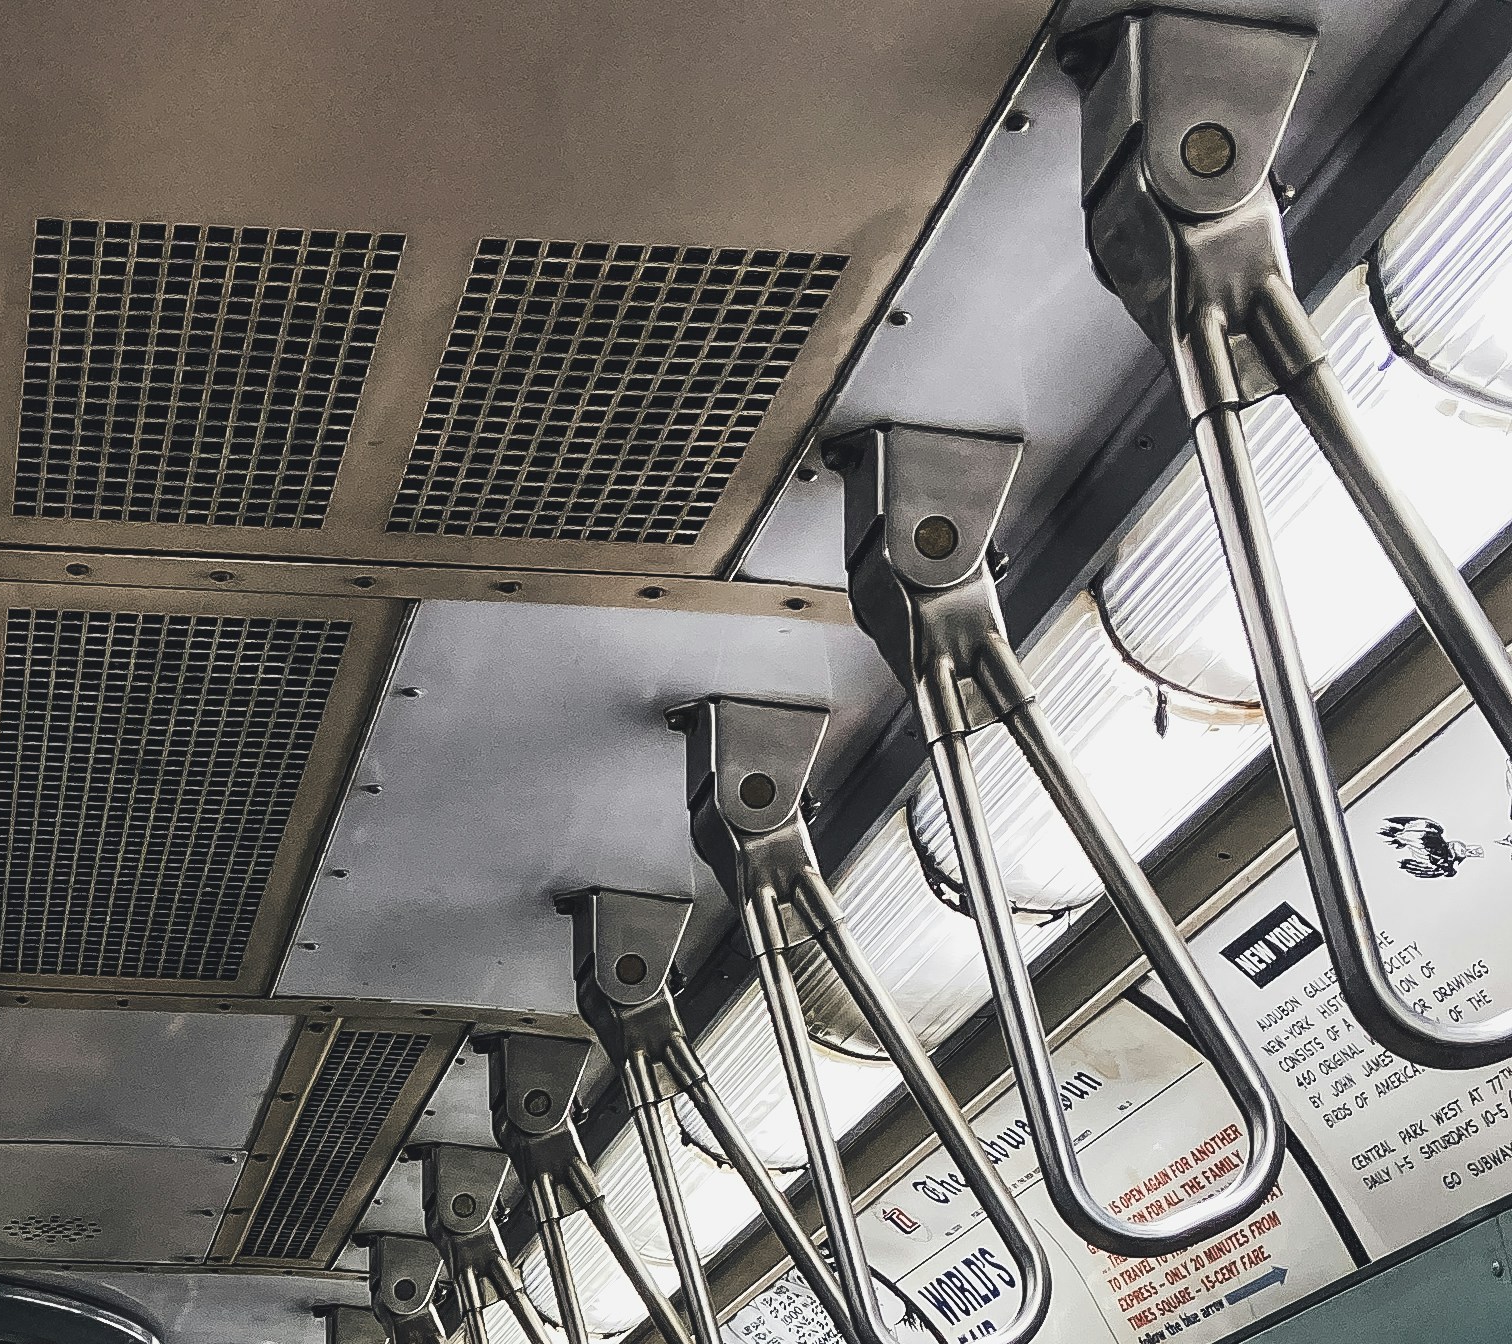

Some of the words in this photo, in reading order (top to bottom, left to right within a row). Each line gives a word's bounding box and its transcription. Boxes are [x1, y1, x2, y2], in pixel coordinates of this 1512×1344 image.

[1235, 941, 1269, 976] NEW
[1265, 914, 1313, 956] YORK
[1256, 996, 1302, 1032] AUDUBON
[1261, 1015, 1315, 1056] NEW-YORK
[1383, 941, 1422, 975] OCIETY
[1278, 1037, 1325, 1073] CONSISTS
[1326, 1025, 1340, 1042] OF
[1421, 960, 1436, 979] OF
[1295, 1069, 1317, 1090] 460
[1319, 1043, 1365, 1076] ORIGINAL
[1432, 959, 1490, 1003] DRAWINGS
[1309, 1094, 1324, 1109] BY
[1331, 1073, 1357, 1098] JOHN
[1362, 1050, 1394, 1077] JAMES
[1449, 1005, 1464, 1023] OF
[1466, 989, 1493, 1013] THE
[1323, 1106, 1352, 1129] BIRDS
[1355, 1092, 1368, 1109] OF
[1374, 1062, 1426, 1098] AMERICA.
[1351, 1140, 1396, 1170] CENTRAL
[1398, 1120, 1428, 1145] PARK
[1430, 1099, 1463, 1126] WEST
[1468, 1087, 1484, 1106] AT
[1108, 1201, 1122, 1215] IS
[1119, 1185, 1146, 1208] OPEN
[1143, 1168, 1172, 1194] AGAIN
[1170, 1156, 1193, 1179] FOR
[1190, 1124, 1244, 1165] ANOTHER
[1145, 1200, 1166, 1219] FOR
[1164, 1190, 1185, 1209] ALL
[1180, 1175, 1205, 1198] THE
[1201, 1149, 1245, 1184] FAMILY
[1362, 1166, 1392, 1190] DAILY
[1394, 1155, 1414, 1174] 1-5
[1419, 1119, 1479, 1159] SATURDAYS
[1481, 1103, 1509, 1127] 10-5
[1443, 1171, 1462, 1189] GO
[912, 1172, 968, 1204] The
[918, 1247, 1016, 1327] WORLD'S
[1107, 1276, 1122, 1292] TO
[1119, 1258, 1155, 1286] TRAVEL
[1118, 1283, 1159, 1313] EXPRESS
[1165, 1260, 1191, 1286] ONLY
[1190, 1254, 1206, 1272] 20
[1203, 1229, 1250, 1265] MINUTES
[1248, 1210, 1282, 1240] FROM
[1127, 1308, 1157, 1331] TIMES
[1158, 1288, 1196, 1317] SQUARE
[1201, 1261, 1241, 1292] 15-CENT
[1239, 1245, 1272, 1272] FARE.
[1165, 1315, 1184, 1334] the
[1182, 1306, 1201, 1326] blue
[1203, 1298, 1226, 1319] arrow
